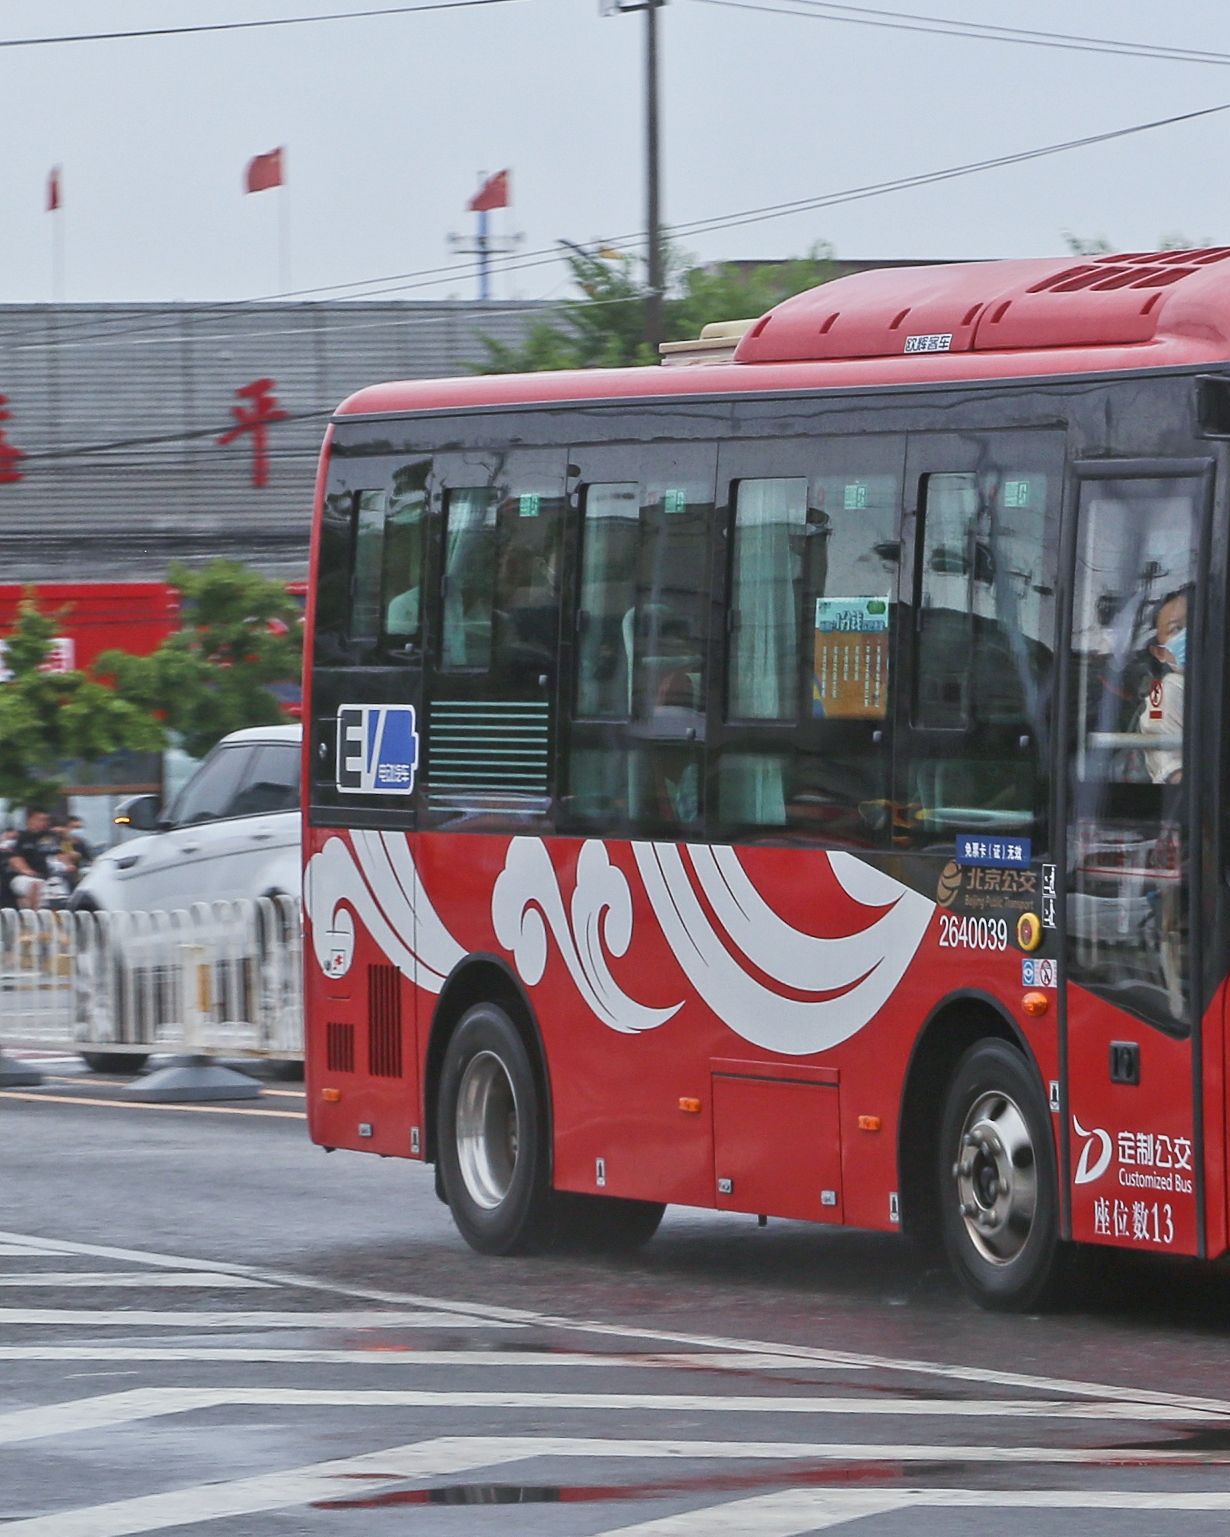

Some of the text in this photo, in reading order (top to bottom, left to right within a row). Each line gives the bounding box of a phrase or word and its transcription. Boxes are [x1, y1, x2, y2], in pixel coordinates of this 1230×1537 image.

[966, 867, 1037, 893] 北京公交
[939, 914, 1008, 951] 2640039
[1117, 1130, 1192, 1171] 定制公交
[1118, 1168, 1193, 1194] Customized Bus
[1094, 1196, 1174, 1243] 座位数13
